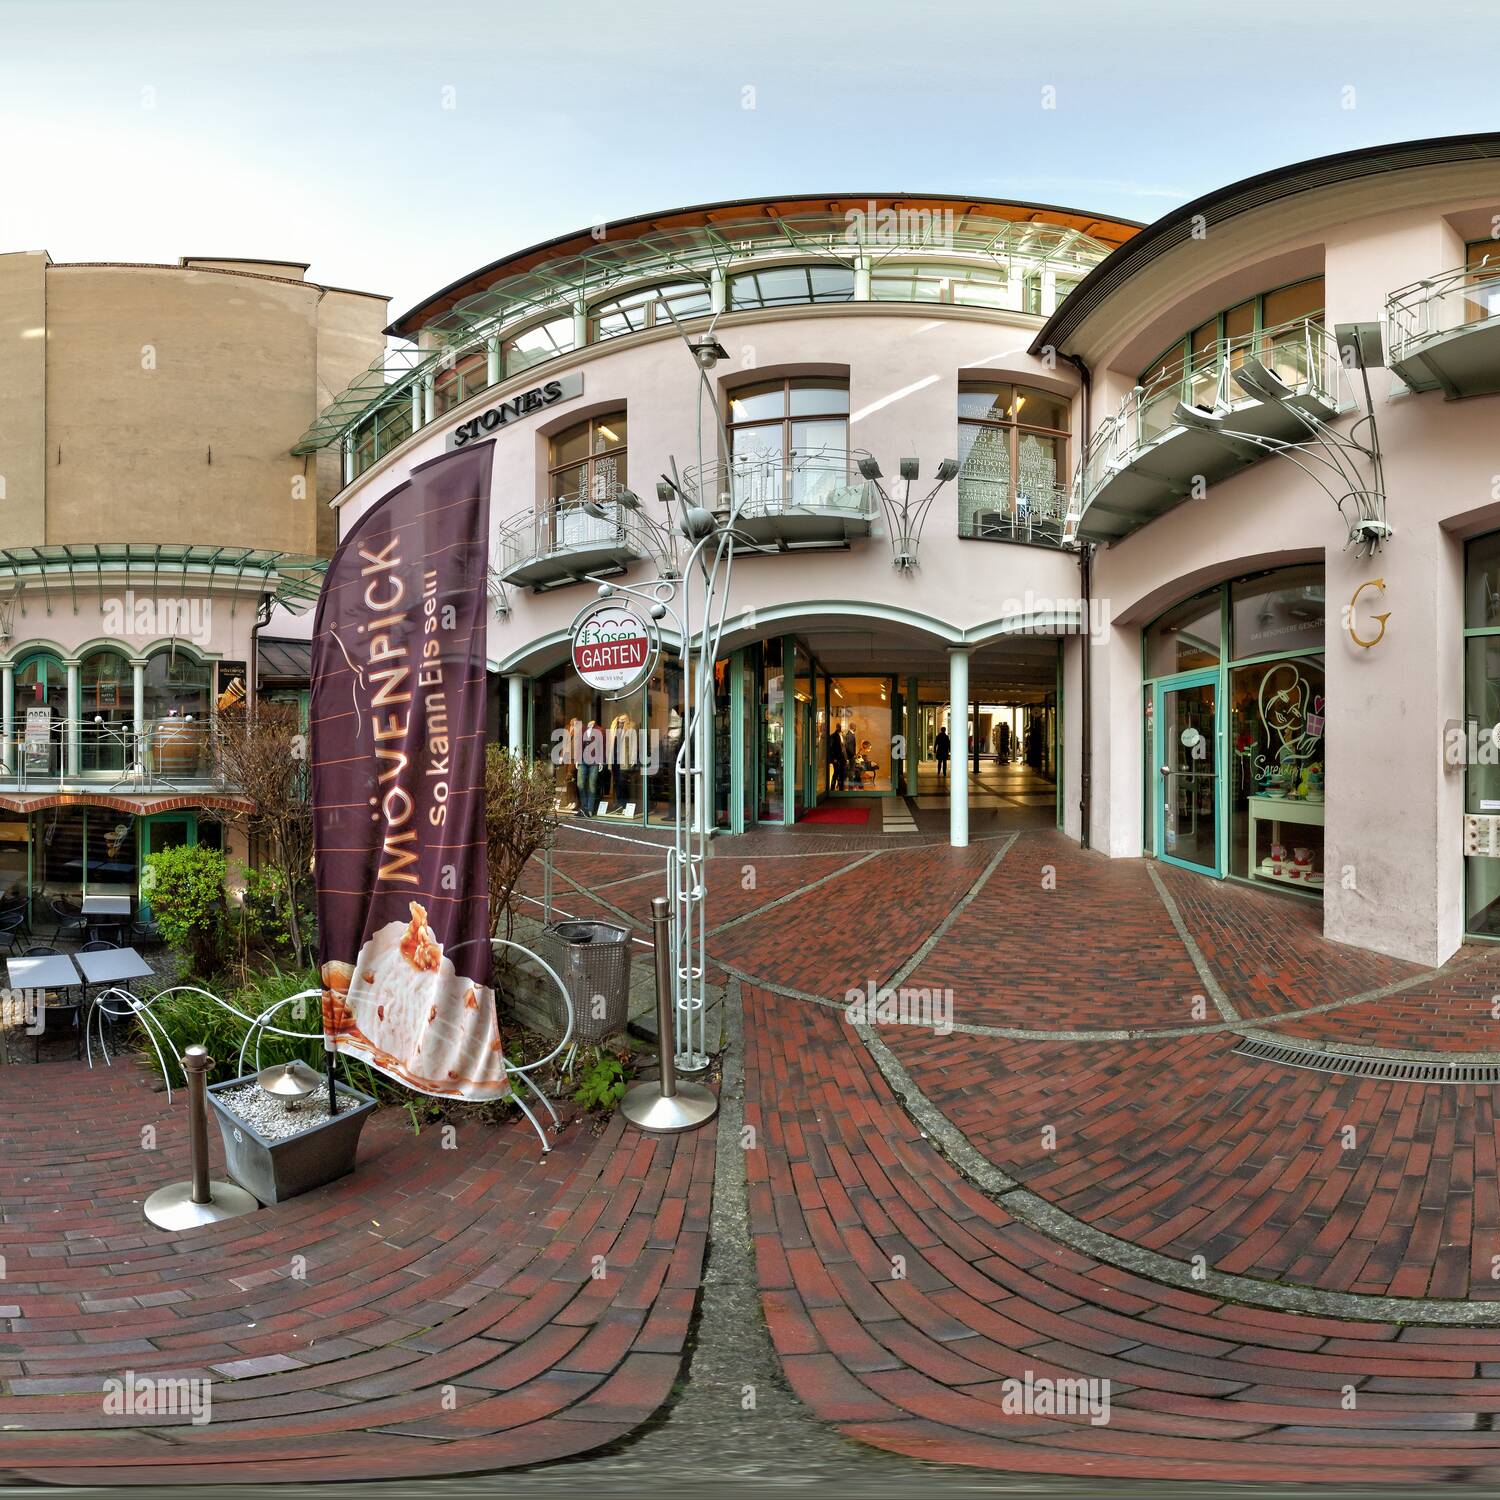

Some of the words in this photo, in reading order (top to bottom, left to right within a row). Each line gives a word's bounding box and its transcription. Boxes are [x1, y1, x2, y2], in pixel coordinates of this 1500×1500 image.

[455, 381, 562, 446] STONES
[418, 639, 443, 687] Eis
[582, 643, 641, 668] GARTEN
[424, 693, 449, 776] kann
